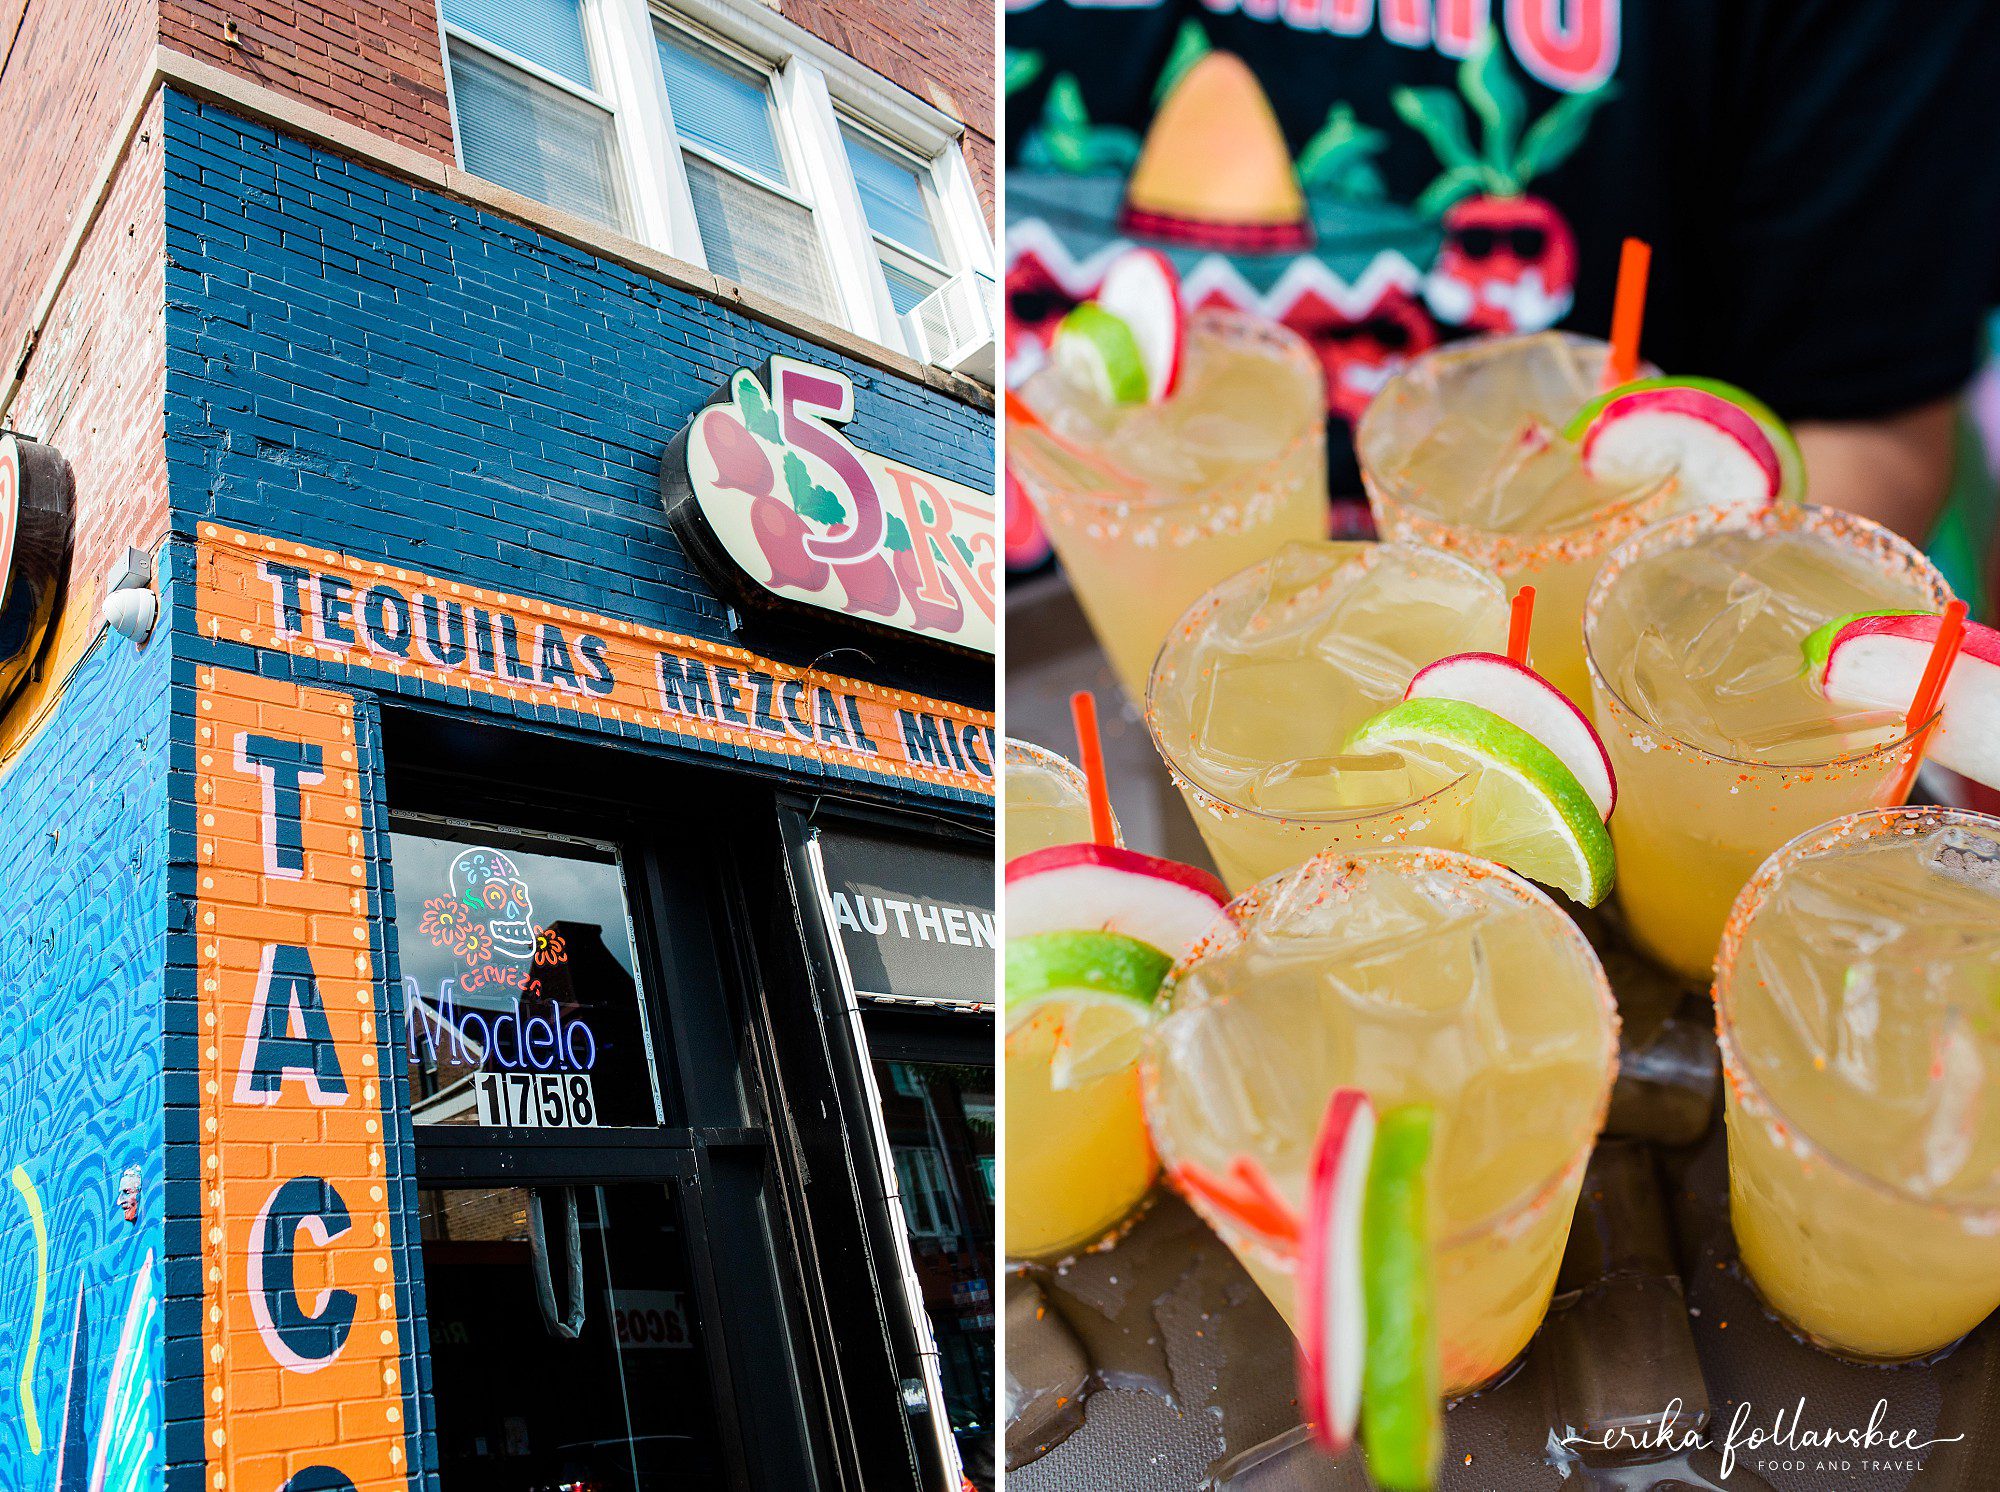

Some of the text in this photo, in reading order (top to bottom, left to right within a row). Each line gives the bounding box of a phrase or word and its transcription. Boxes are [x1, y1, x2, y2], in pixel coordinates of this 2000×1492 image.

[782, 369, 883, 560] 5
[256, 561, 614, 697] TEQUILAS
[655, 651, 878, 757] MEZCAL
[232, 731, 358, 1492] TAC
[404, 975, 596, 1070] Modelo
[481, 1074, 594, 1127] 1758
